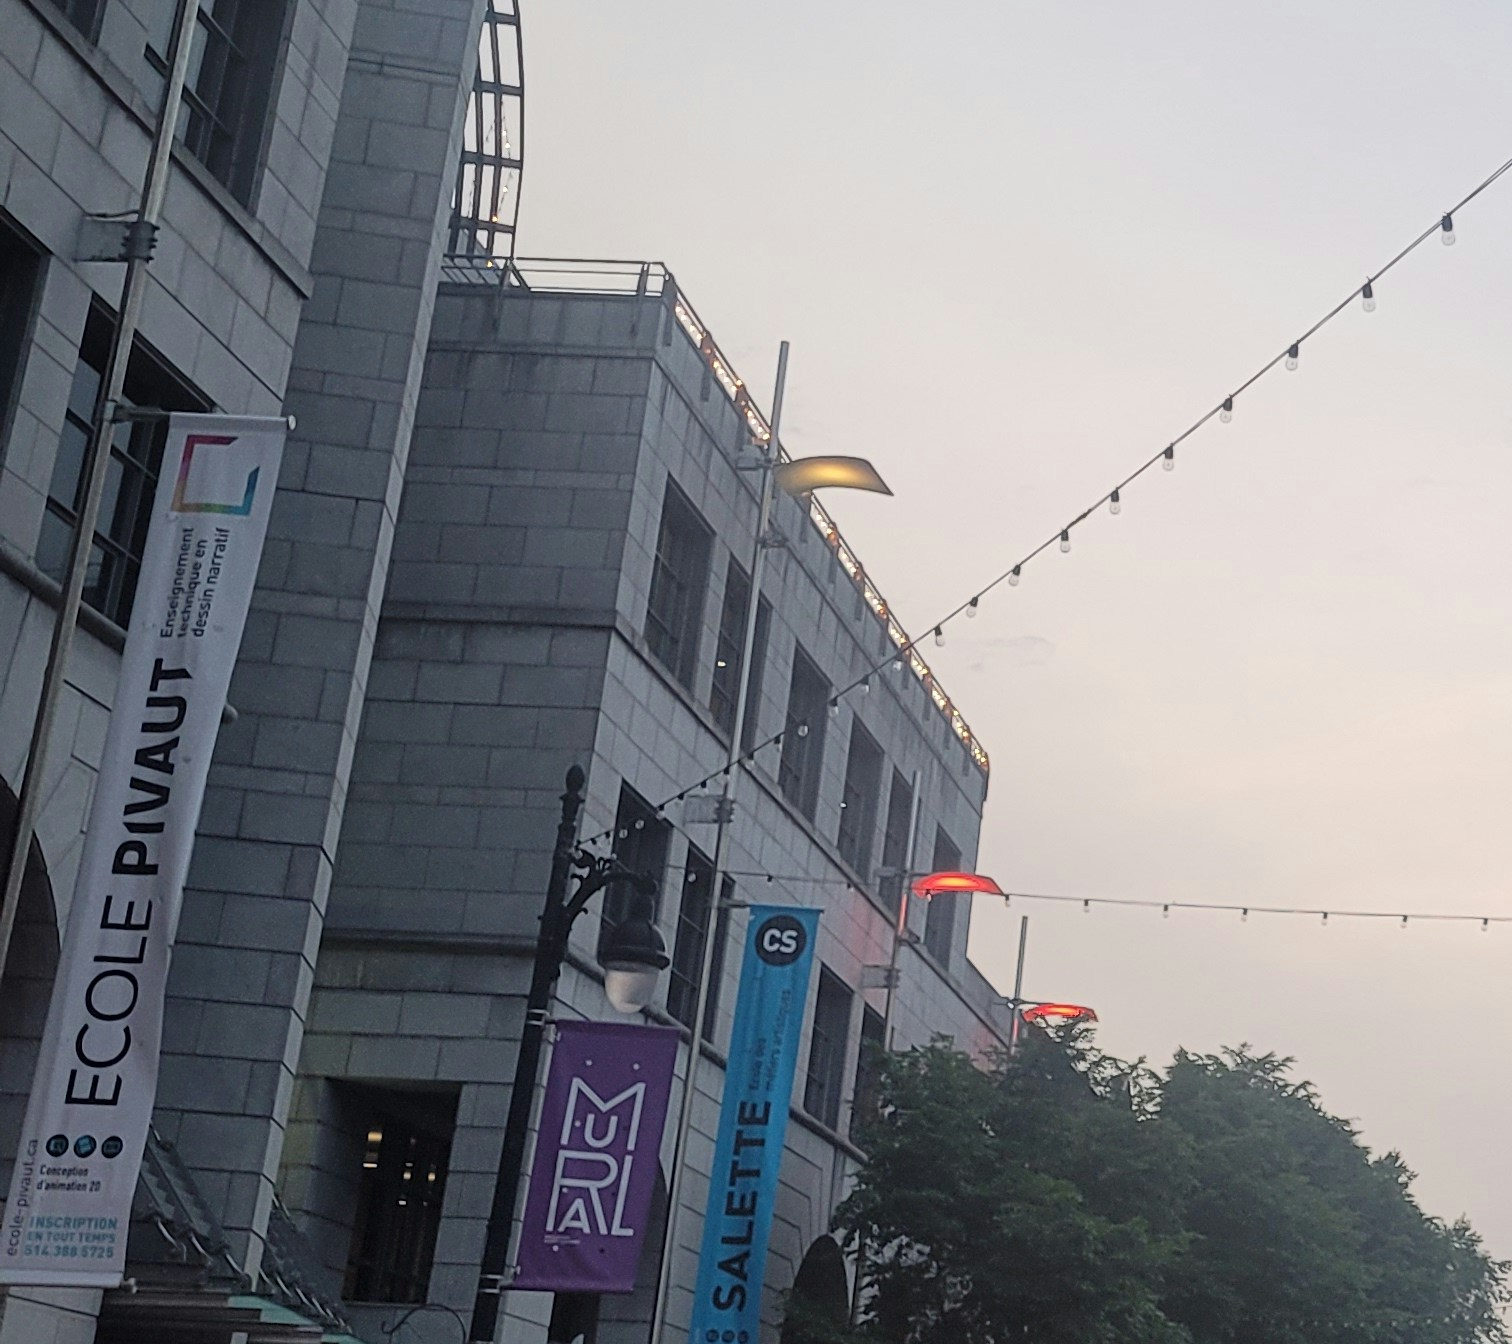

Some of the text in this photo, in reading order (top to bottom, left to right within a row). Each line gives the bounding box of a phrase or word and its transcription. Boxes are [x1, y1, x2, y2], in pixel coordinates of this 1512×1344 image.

[160, 527, 194, 638] Enseignement
[177, 539, 208, 638] technique en
[191, 527, 230, 637] dessin narratif
[65, 658, 193, 1106] ECOLE PIVAUT
[762, 927, 798, 954] CS
[8, 1139, 38, 1256] ecole-pivaut.ca
[27, 1231, 117, 1244] EN TOUT TEMPS
[29, 1216, 118, 1229] INSCRIPTION
[712, 1101, 771, 1313] SALETTE
